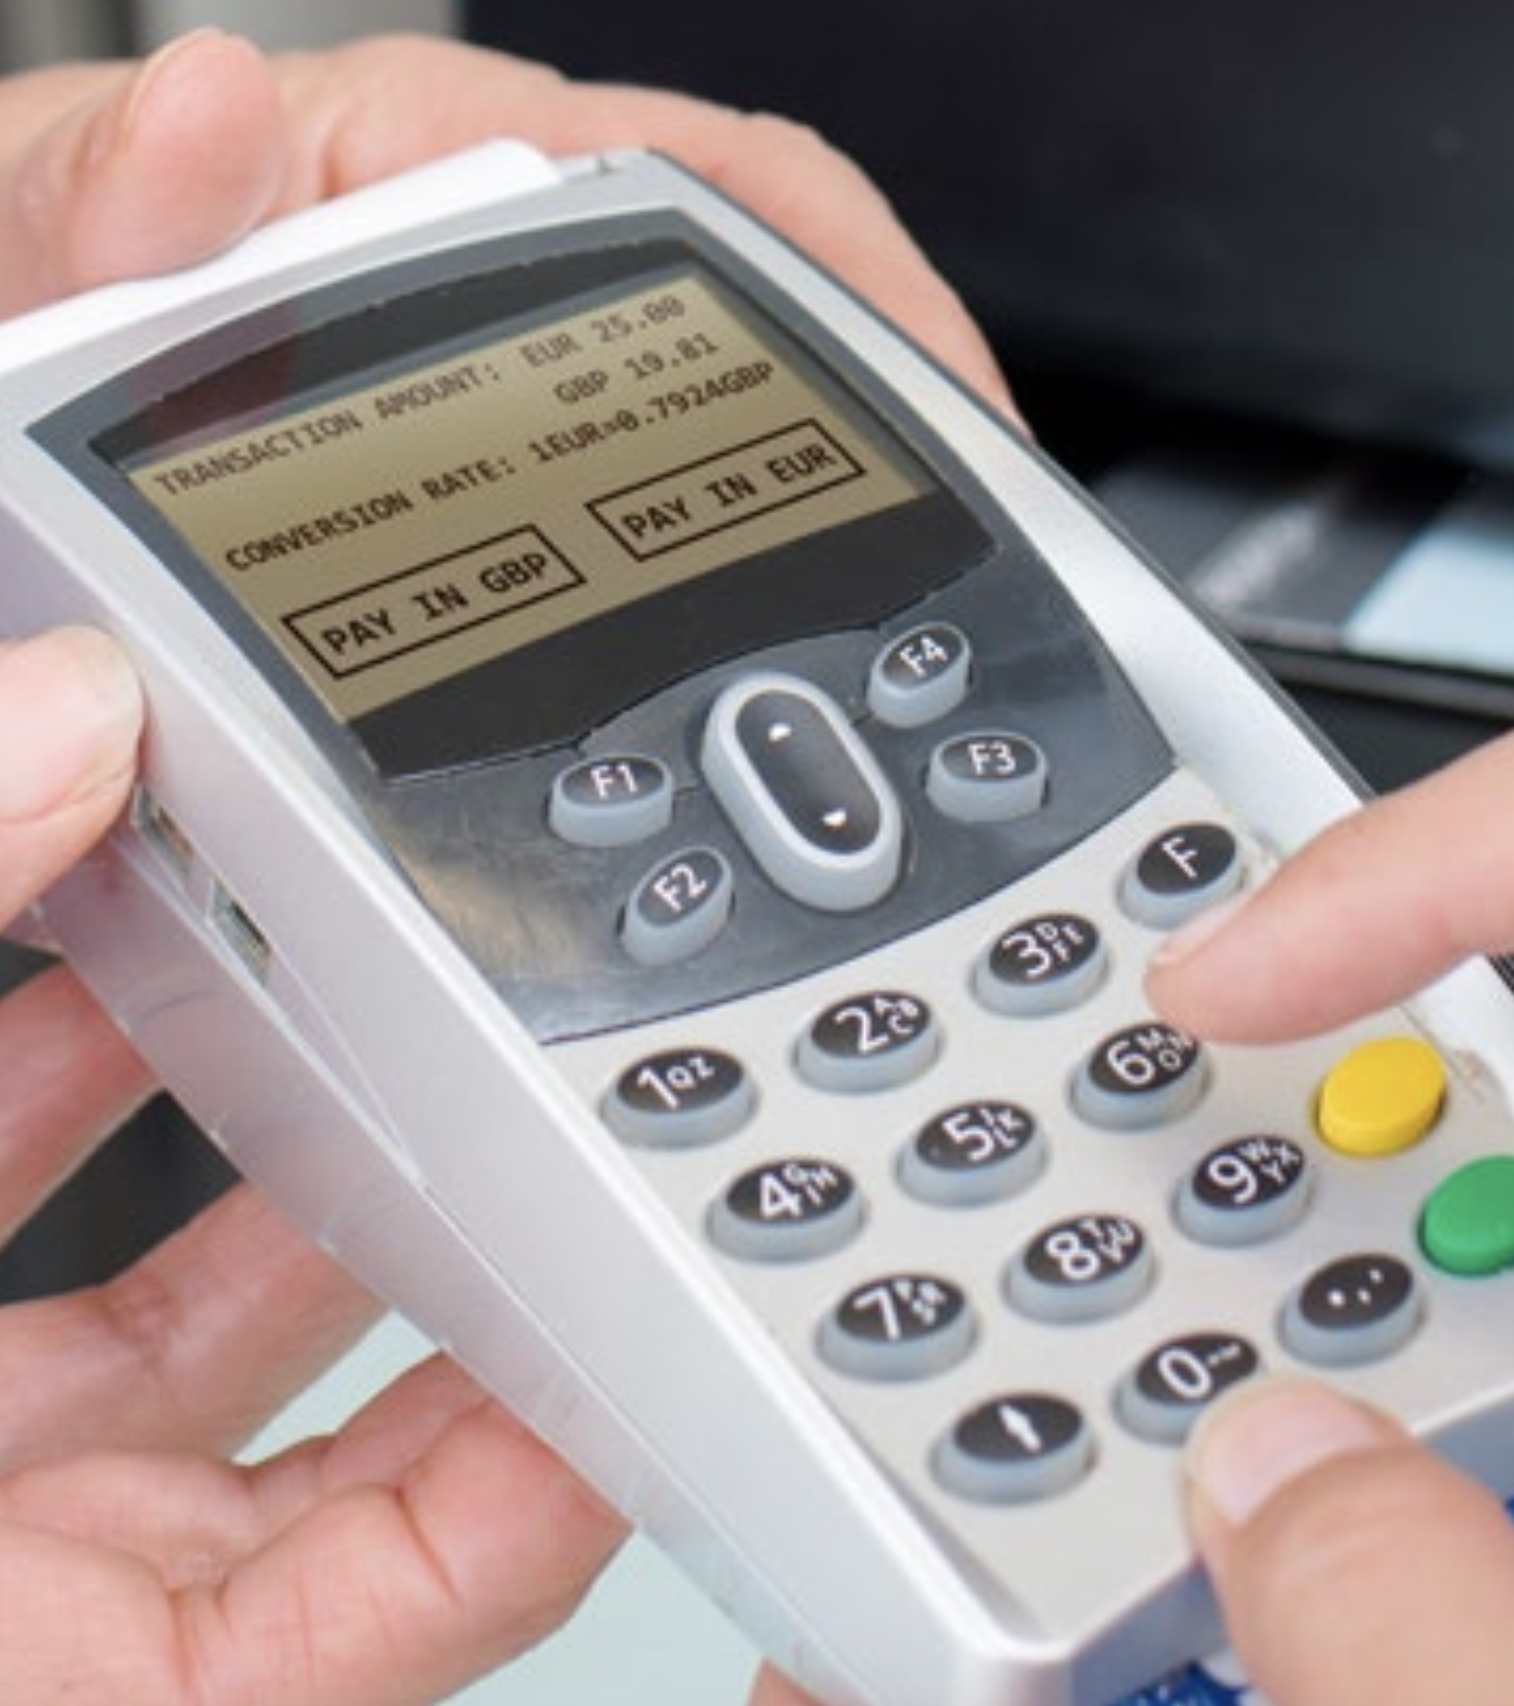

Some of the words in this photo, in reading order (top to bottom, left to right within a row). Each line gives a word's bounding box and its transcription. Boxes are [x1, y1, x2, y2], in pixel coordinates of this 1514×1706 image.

[154, 411, 362, 496] TRANSACTION
[373, 363, 499, 419] AMOUNT:
[519, 333, 583, 367] EUR
[591, 295, 686, 342] 25.00
[553, 370, 609, 403] GBP
[624, 333, 719, 380] 19.81
[224, 489, 414, 572] CONVERSION
[421, 457, 516, 502] RATE:
[620, 498, 693, 539] PAY
[705, 472, 758, 508] IN
[765, 443, 837, 484] EUR
[320, 610, 397, 656] PAY
[412, 583, 469, 623] IN
[479, 552, 548, 594] GBP
[900, 636, 948, 678] F4
[590, 764, 639, 799] F1
[967, 743, 1017, 776] F3
[1160, 836, 1198, 879] F
[652, 863, 707, 913] F2
